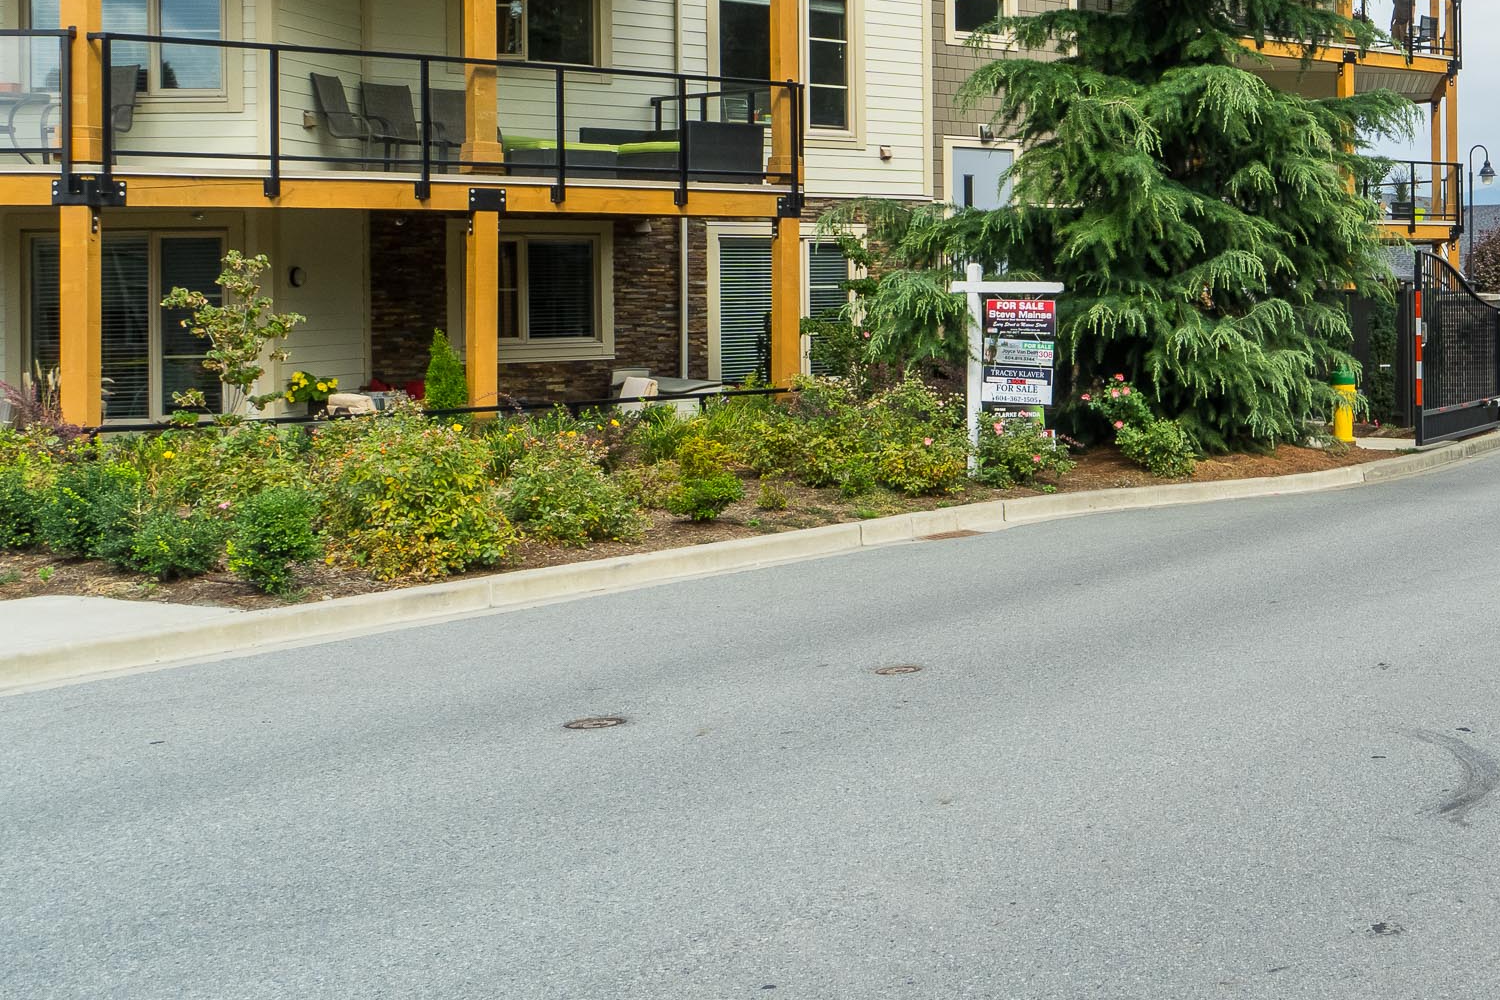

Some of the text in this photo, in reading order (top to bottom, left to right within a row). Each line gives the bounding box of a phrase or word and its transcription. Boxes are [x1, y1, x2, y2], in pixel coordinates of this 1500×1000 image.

[996, 301, 1045, 311] FOR SALE
[1038, 351, 1052, 359] 308
[991, 369, 1045, 378] TRACEY KLAVER
[996, 384, 1038, 394] FOR SALE
